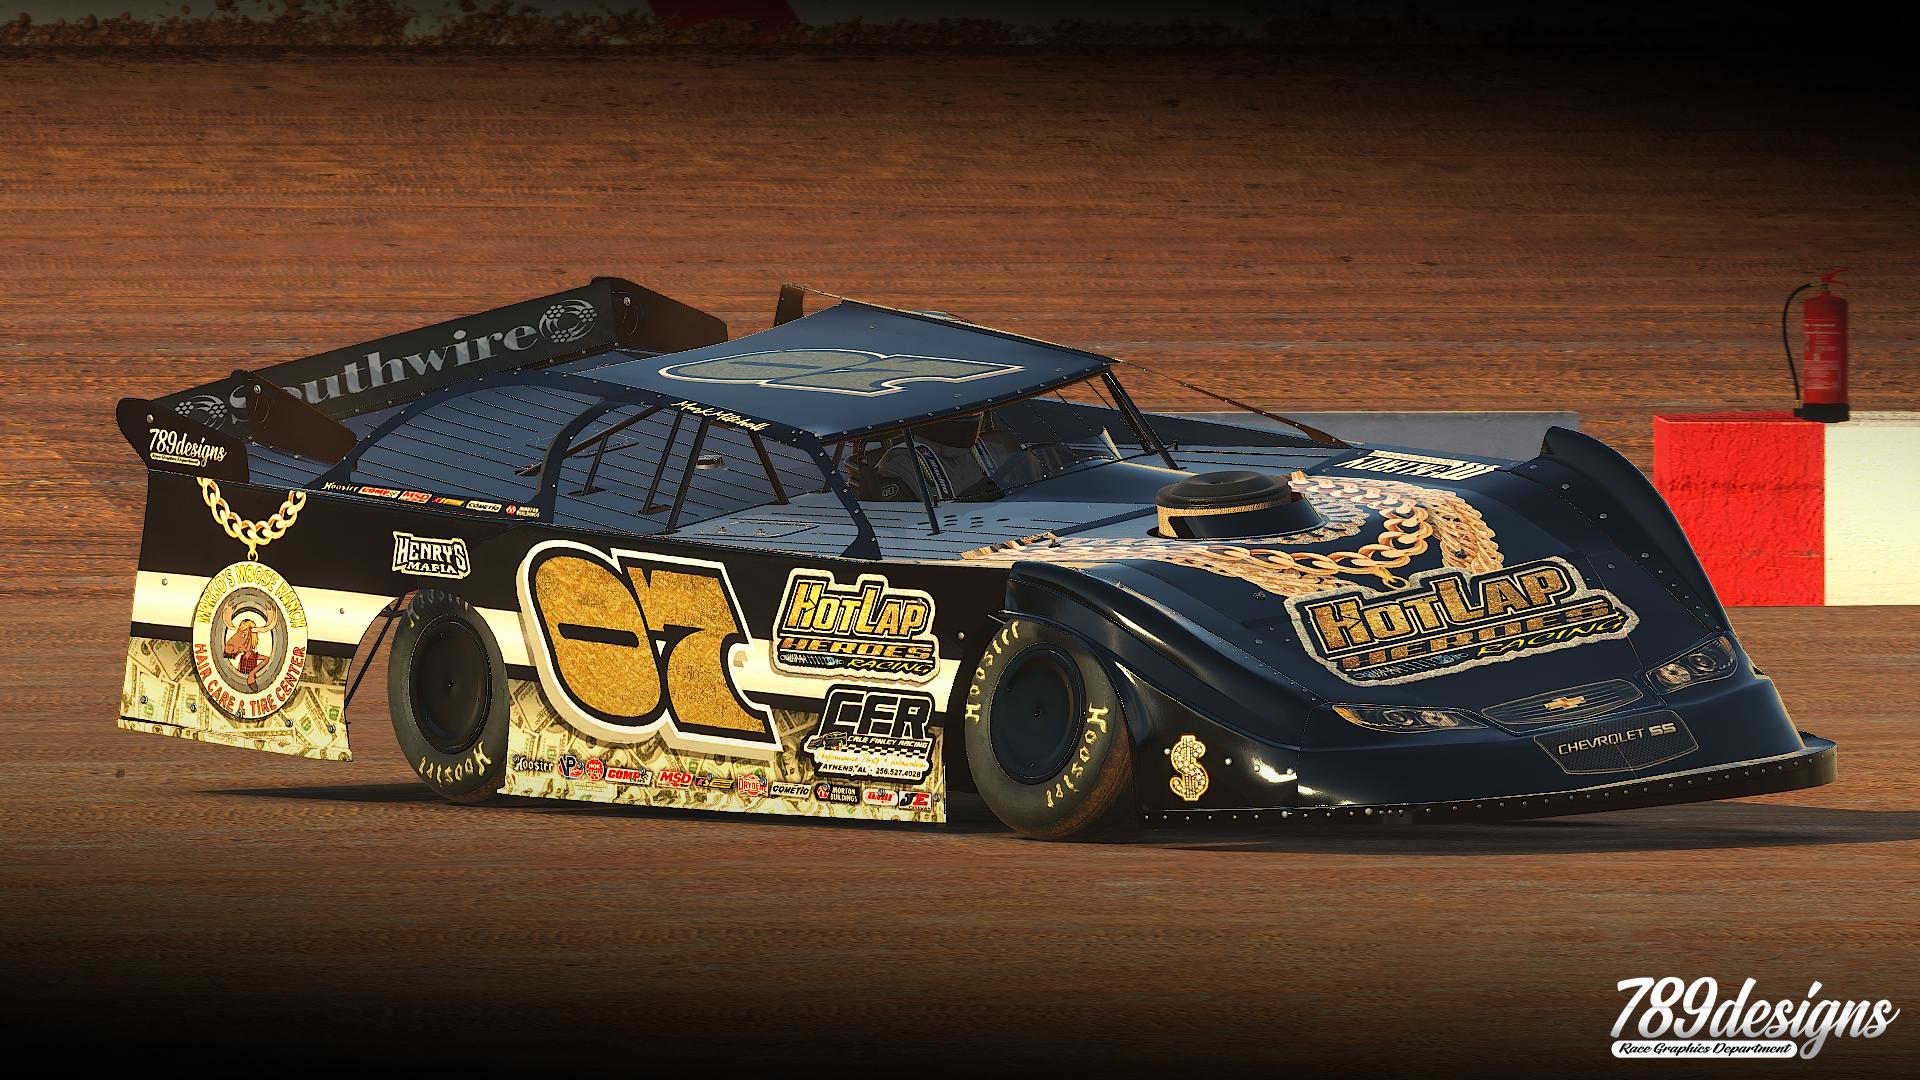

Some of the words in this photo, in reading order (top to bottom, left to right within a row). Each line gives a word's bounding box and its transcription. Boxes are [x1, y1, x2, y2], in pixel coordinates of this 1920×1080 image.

[229, 329, 538, 425] Suthwire
[149, 428, 228, 467] 789designs
[406, 561, 458, 574] MAFIA
[235, 563, 280, 593] MOOSE
[275, 580, 308, 629] RANCH
[1342, 600, 1610, 669] HEROES
[1476, 612, 1624, 657] RACING
[780, 637, 934, 661] HEROES
[847, 658, 934, 674] RACING
[194, 642, 213, 680] HAIR
[207, 679, 236, 713] CARE
[249, 693, 278, 717] TIRE
[275, 646, 306, 702] CENTER
[818, 689, 932, 739] CFR
[897, 739, 929, 749] RACING
[1558, 728, 1645, 755] CHEVROLET
[1648, 722, 1677, 737] SS
[513, 755, 554, 773] Hoosier
[607, 769, 641, 780] COMP
[822, 763, 856, 773] ATHENS,
[875, 767, 921, 778] 256.527.4028
[659, 771, 692, 784] MSD
[830, 792, 858, 803] BUILDINGS
[832, 786, 856, 796] MORTON
